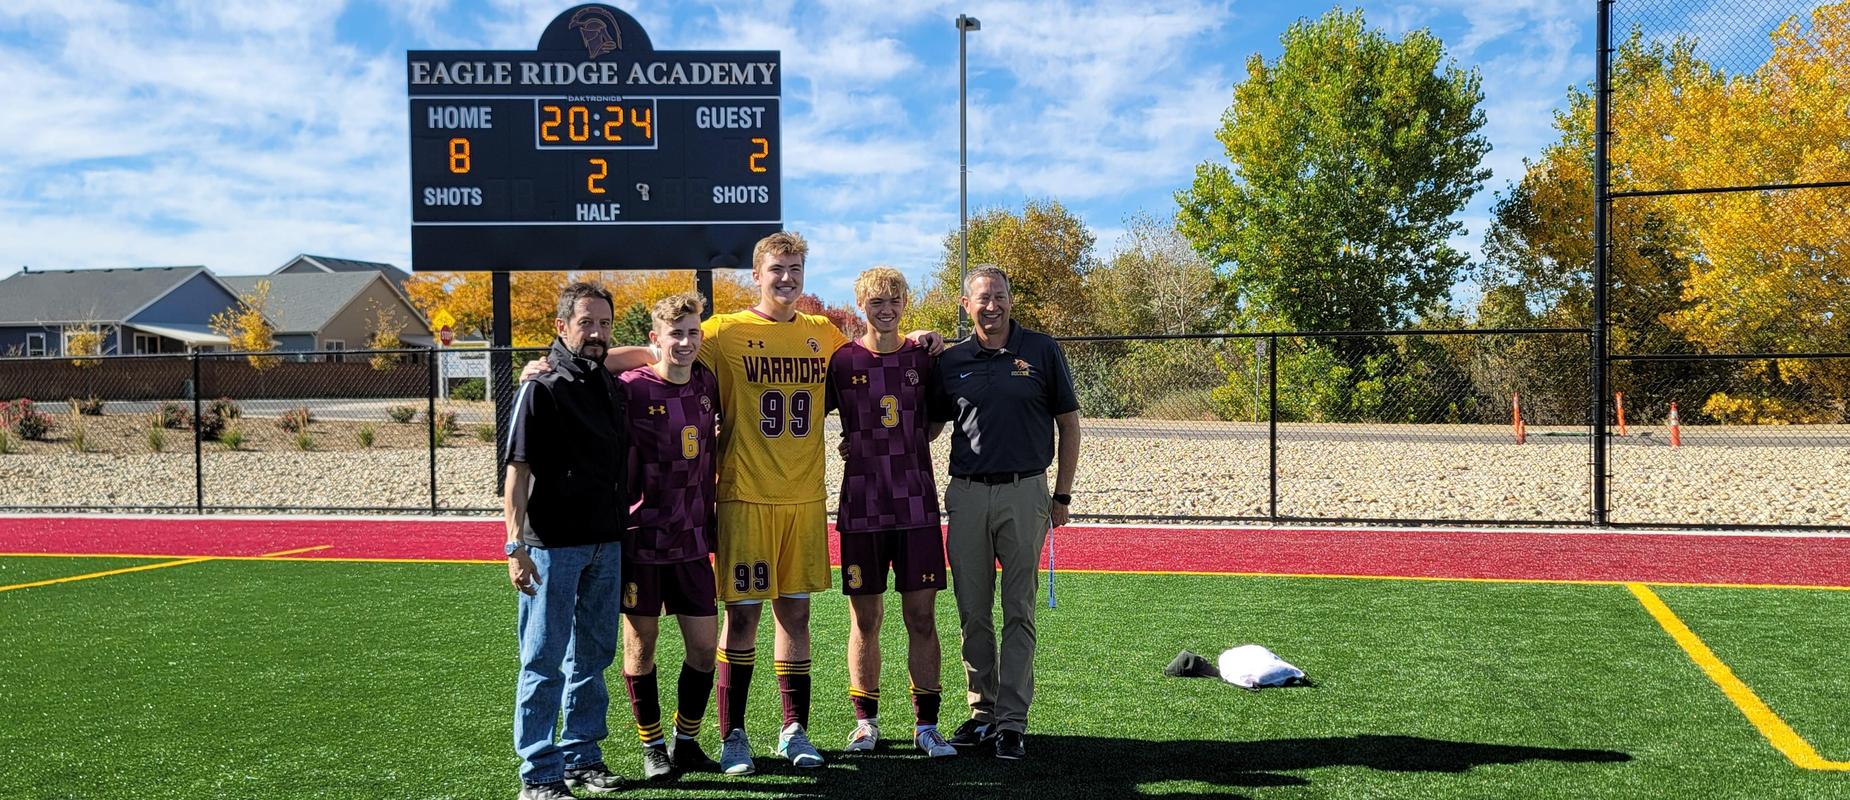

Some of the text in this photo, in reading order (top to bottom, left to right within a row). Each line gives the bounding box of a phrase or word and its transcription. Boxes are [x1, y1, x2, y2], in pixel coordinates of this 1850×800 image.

[411, 62, 777, 85] EAGLE RIDGE ACADEMY
[428, 107, 493, 129] HOME
[541, 105, 651, 142] 20:24
[696, 107, 766, 129] GUEST
[449, 137, 471, 174] 8
[749, 137, 769, 173] 2
[587, 158, 608, 194] 2
[424, 187, 483, 206] SHOTS
[712, 186, 769, 204] SHOTS
[576, 203, 621, 222] HALF
[760, 388, 813, 438] 99
[879, 394, 900, 428] 3
[681, 425, 699, 460] 6
[733, 560, 770, 594] 99
[847, 564, 863, 589] 3
